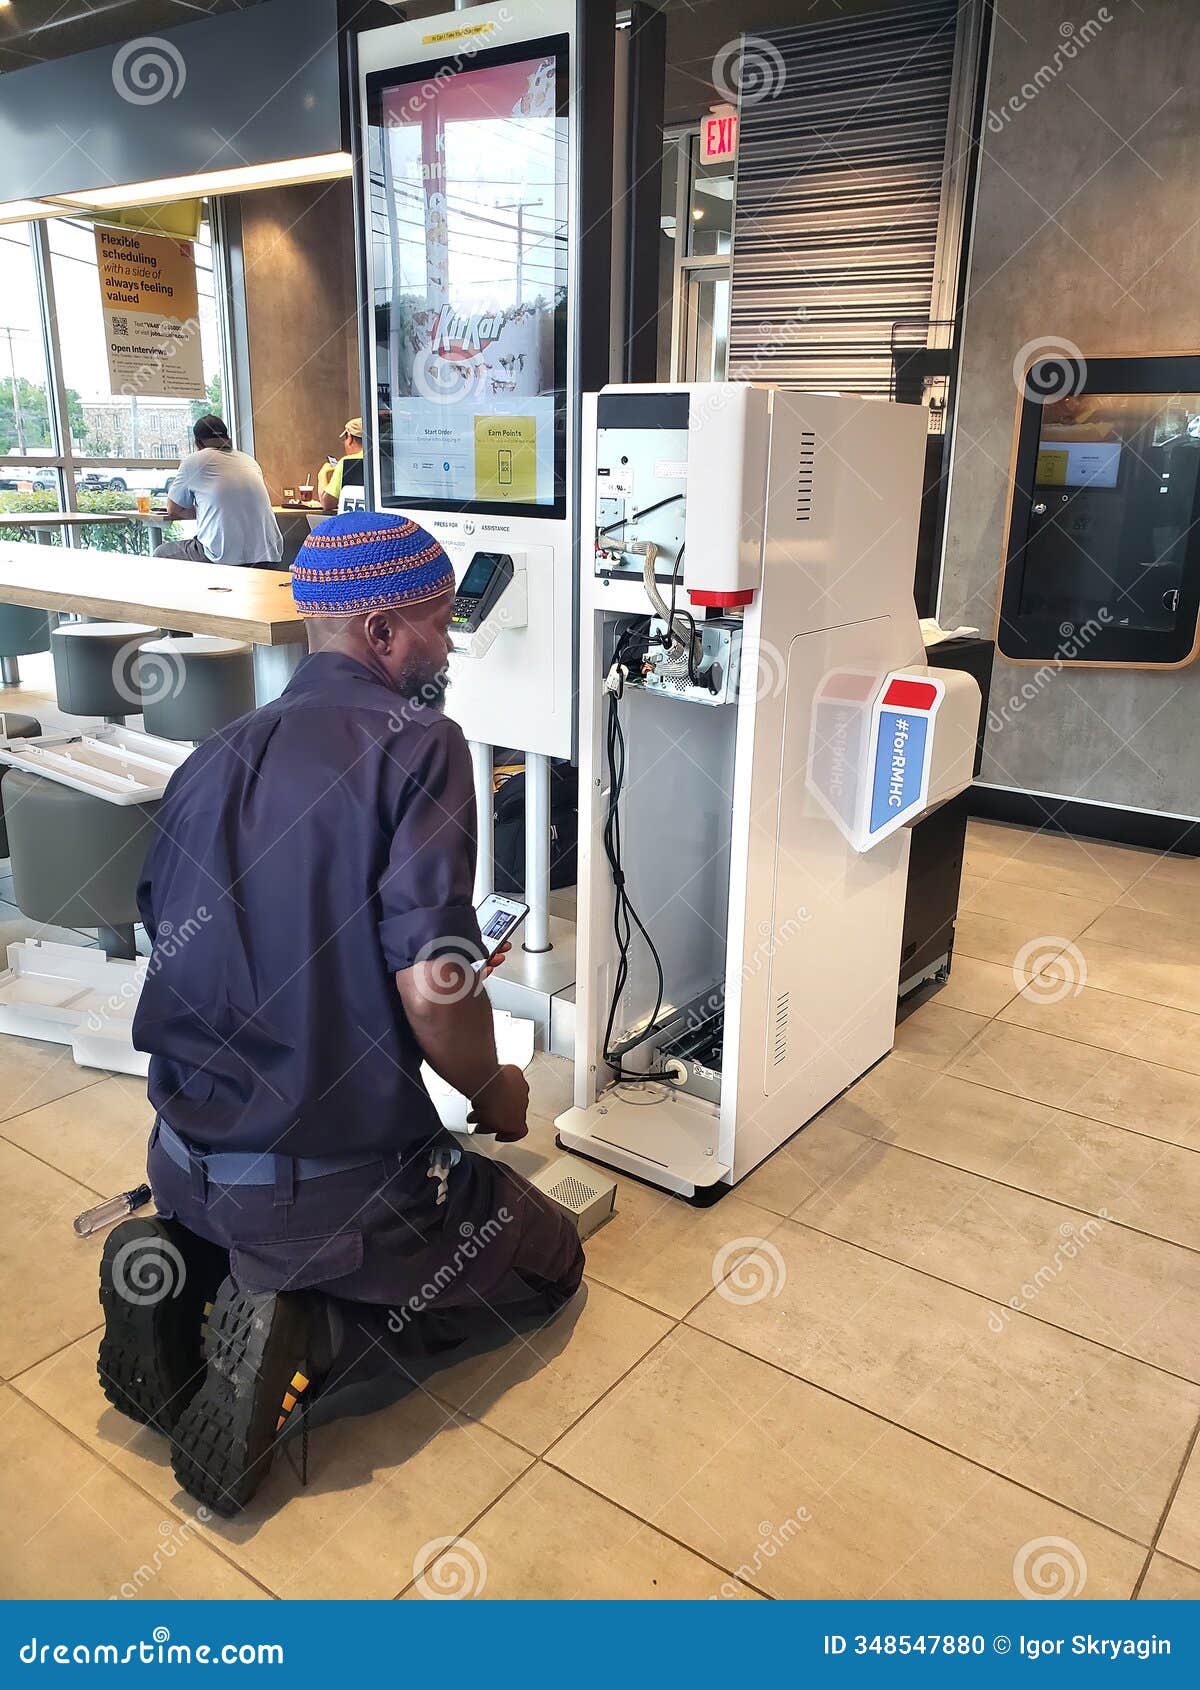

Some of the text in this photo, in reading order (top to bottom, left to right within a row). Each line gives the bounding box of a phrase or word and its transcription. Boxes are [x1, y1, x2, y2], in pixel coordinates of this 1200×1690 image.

[707, 116, 737, 156] EXI
[101, 233, 140, 249] Flexible
[103, 249, 157, 267] scheduling
[104, 263, 124, 274] with
[132, 266, 151, 279] side
[152, 269, 162, 280] of
[105, 277, 174, 296] always feeling
[107, 292, 140, 303] valued
[111, 343, 131, 353] Open
[888, 718, 910, 808] #forRMHC
